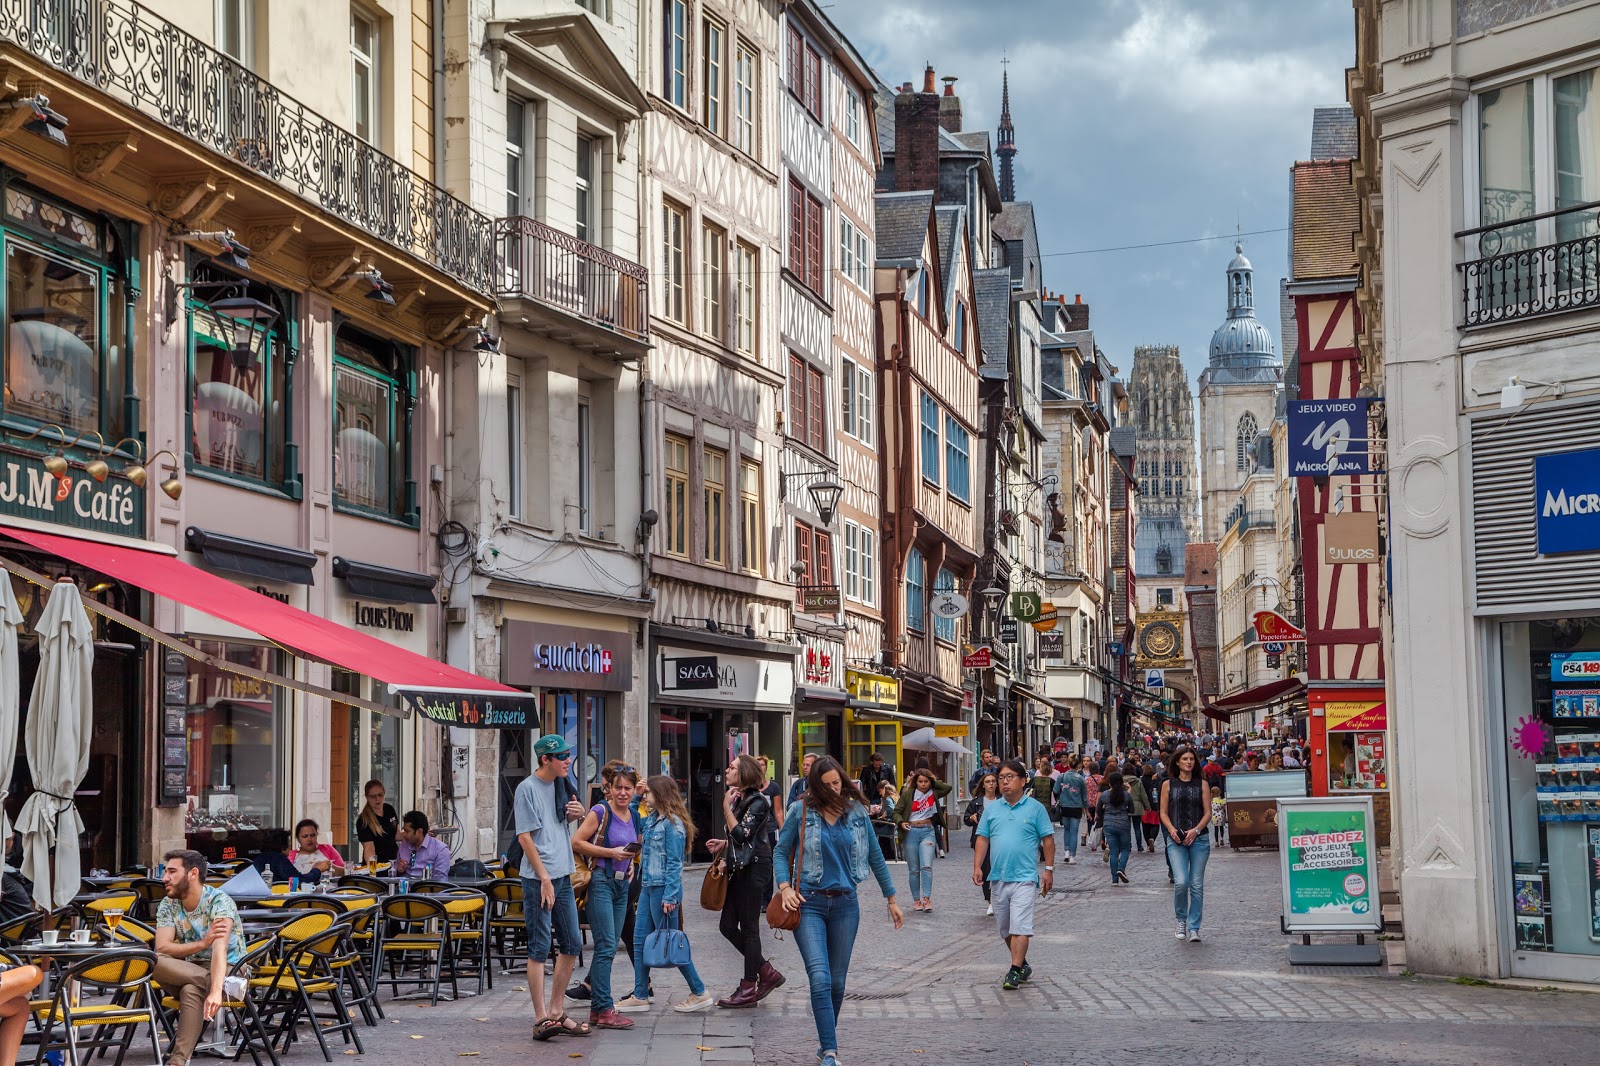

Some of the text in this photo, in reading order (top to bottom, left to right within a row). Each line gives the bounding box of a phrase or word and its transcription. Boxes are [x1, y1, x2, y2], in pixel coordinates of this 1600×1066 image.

[1298, 404, 1356, 413] JEUX VIDEO
[1295, 460, 1361, 471] MICROANIA
[74, 479, 134, 526] Café
[1542, 488, 1600, 517] MICR
[1266, 642, 1282, 650] C&A
[534, 642, 602, 673] swatch
[680, 665, 714, 679] SAGA
[1562, 665, 1582, 673] PS4
[416, 696, 526, 725] Cocktail Pub Brasserie
[1346, 720, 1370, 730] Crêpes
[1292, 832, 1362, 846] REVENDEZ
[1304, 851, 1351, 860] CONSOLES
[1304, 858, 1363, 869] ACCESSOIRES
